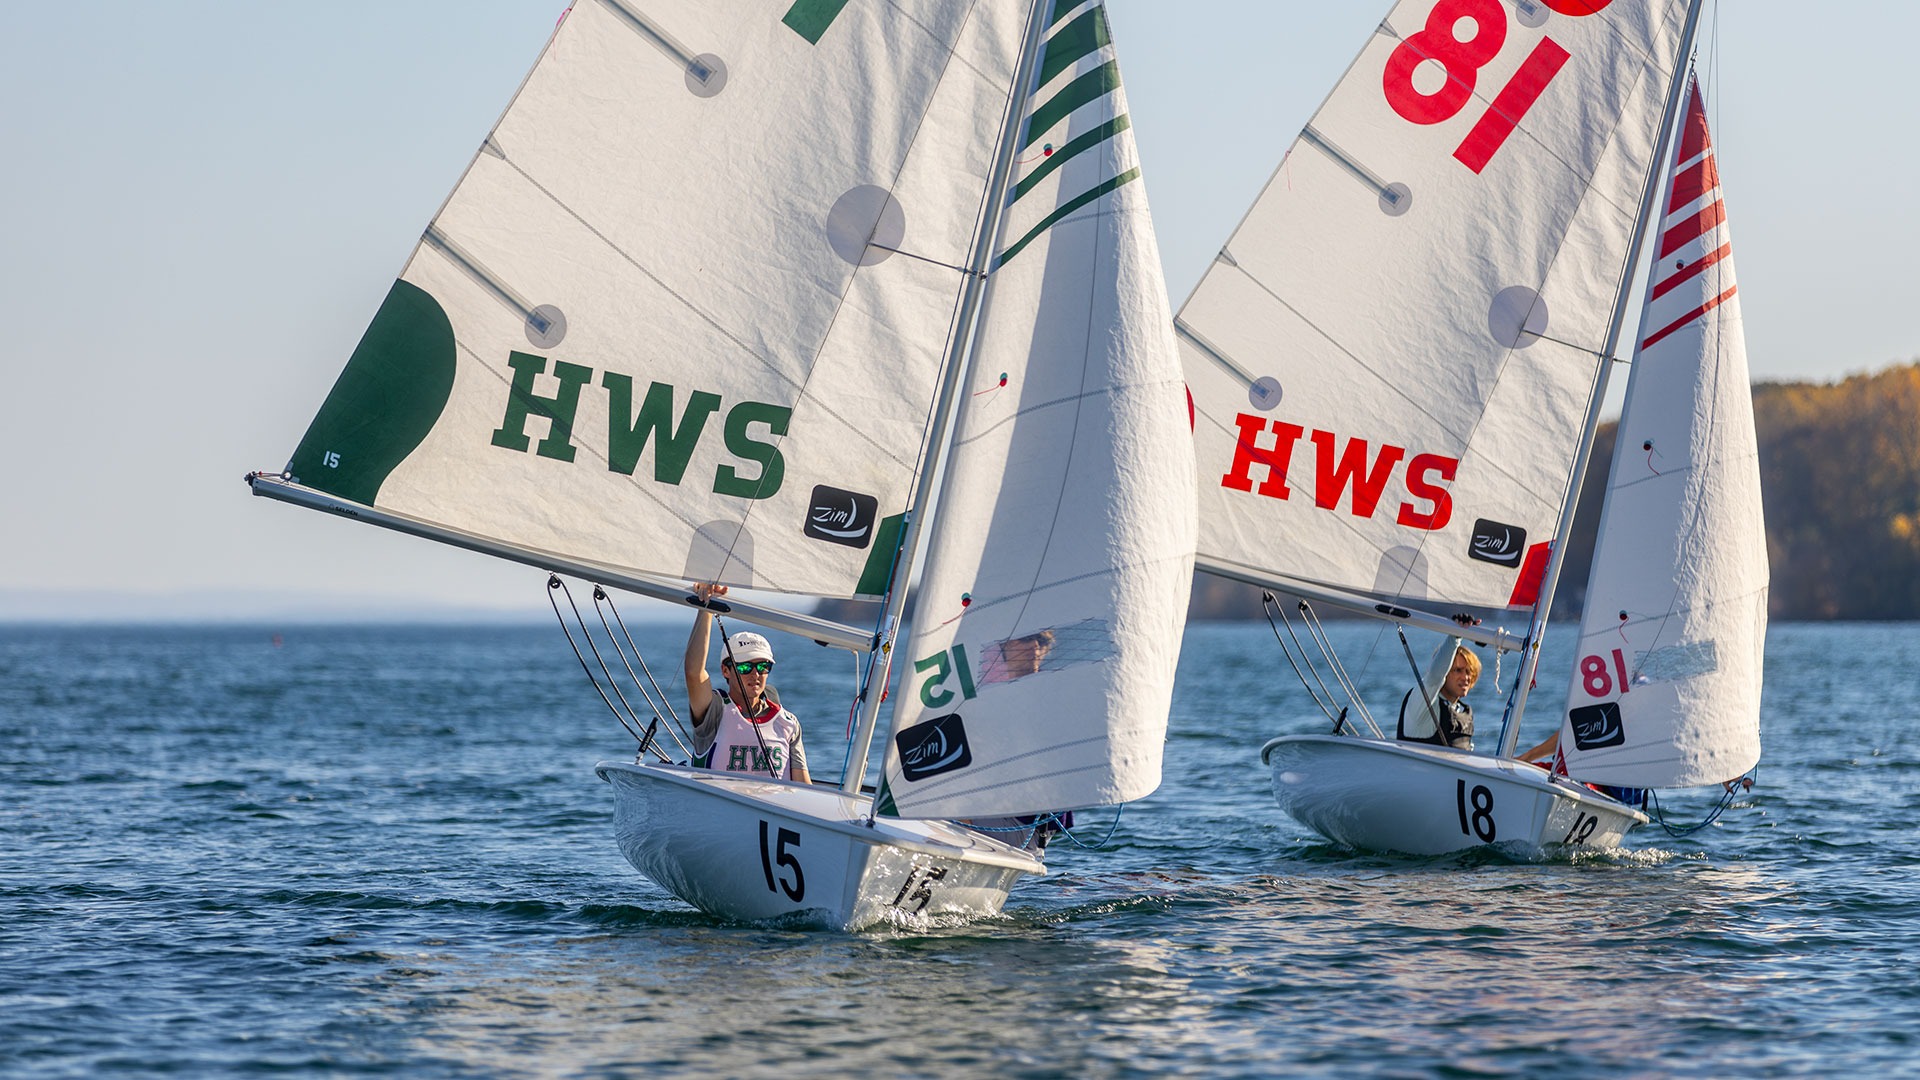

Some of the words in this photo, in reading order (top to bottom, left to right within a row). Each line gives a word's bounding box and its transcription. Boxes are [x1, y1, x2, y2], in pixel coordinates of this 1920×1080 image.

[493, 350, 792, 500] HWS
[323, 450, 341, 469] 15
[1221, 413, 1459, 530] HWS
[726, 745, 783, 772] HWS
[1457, 779, 1497, 844] 18
[759, 819, 806, 903] 15
[892, 866, 948, 915] 15
